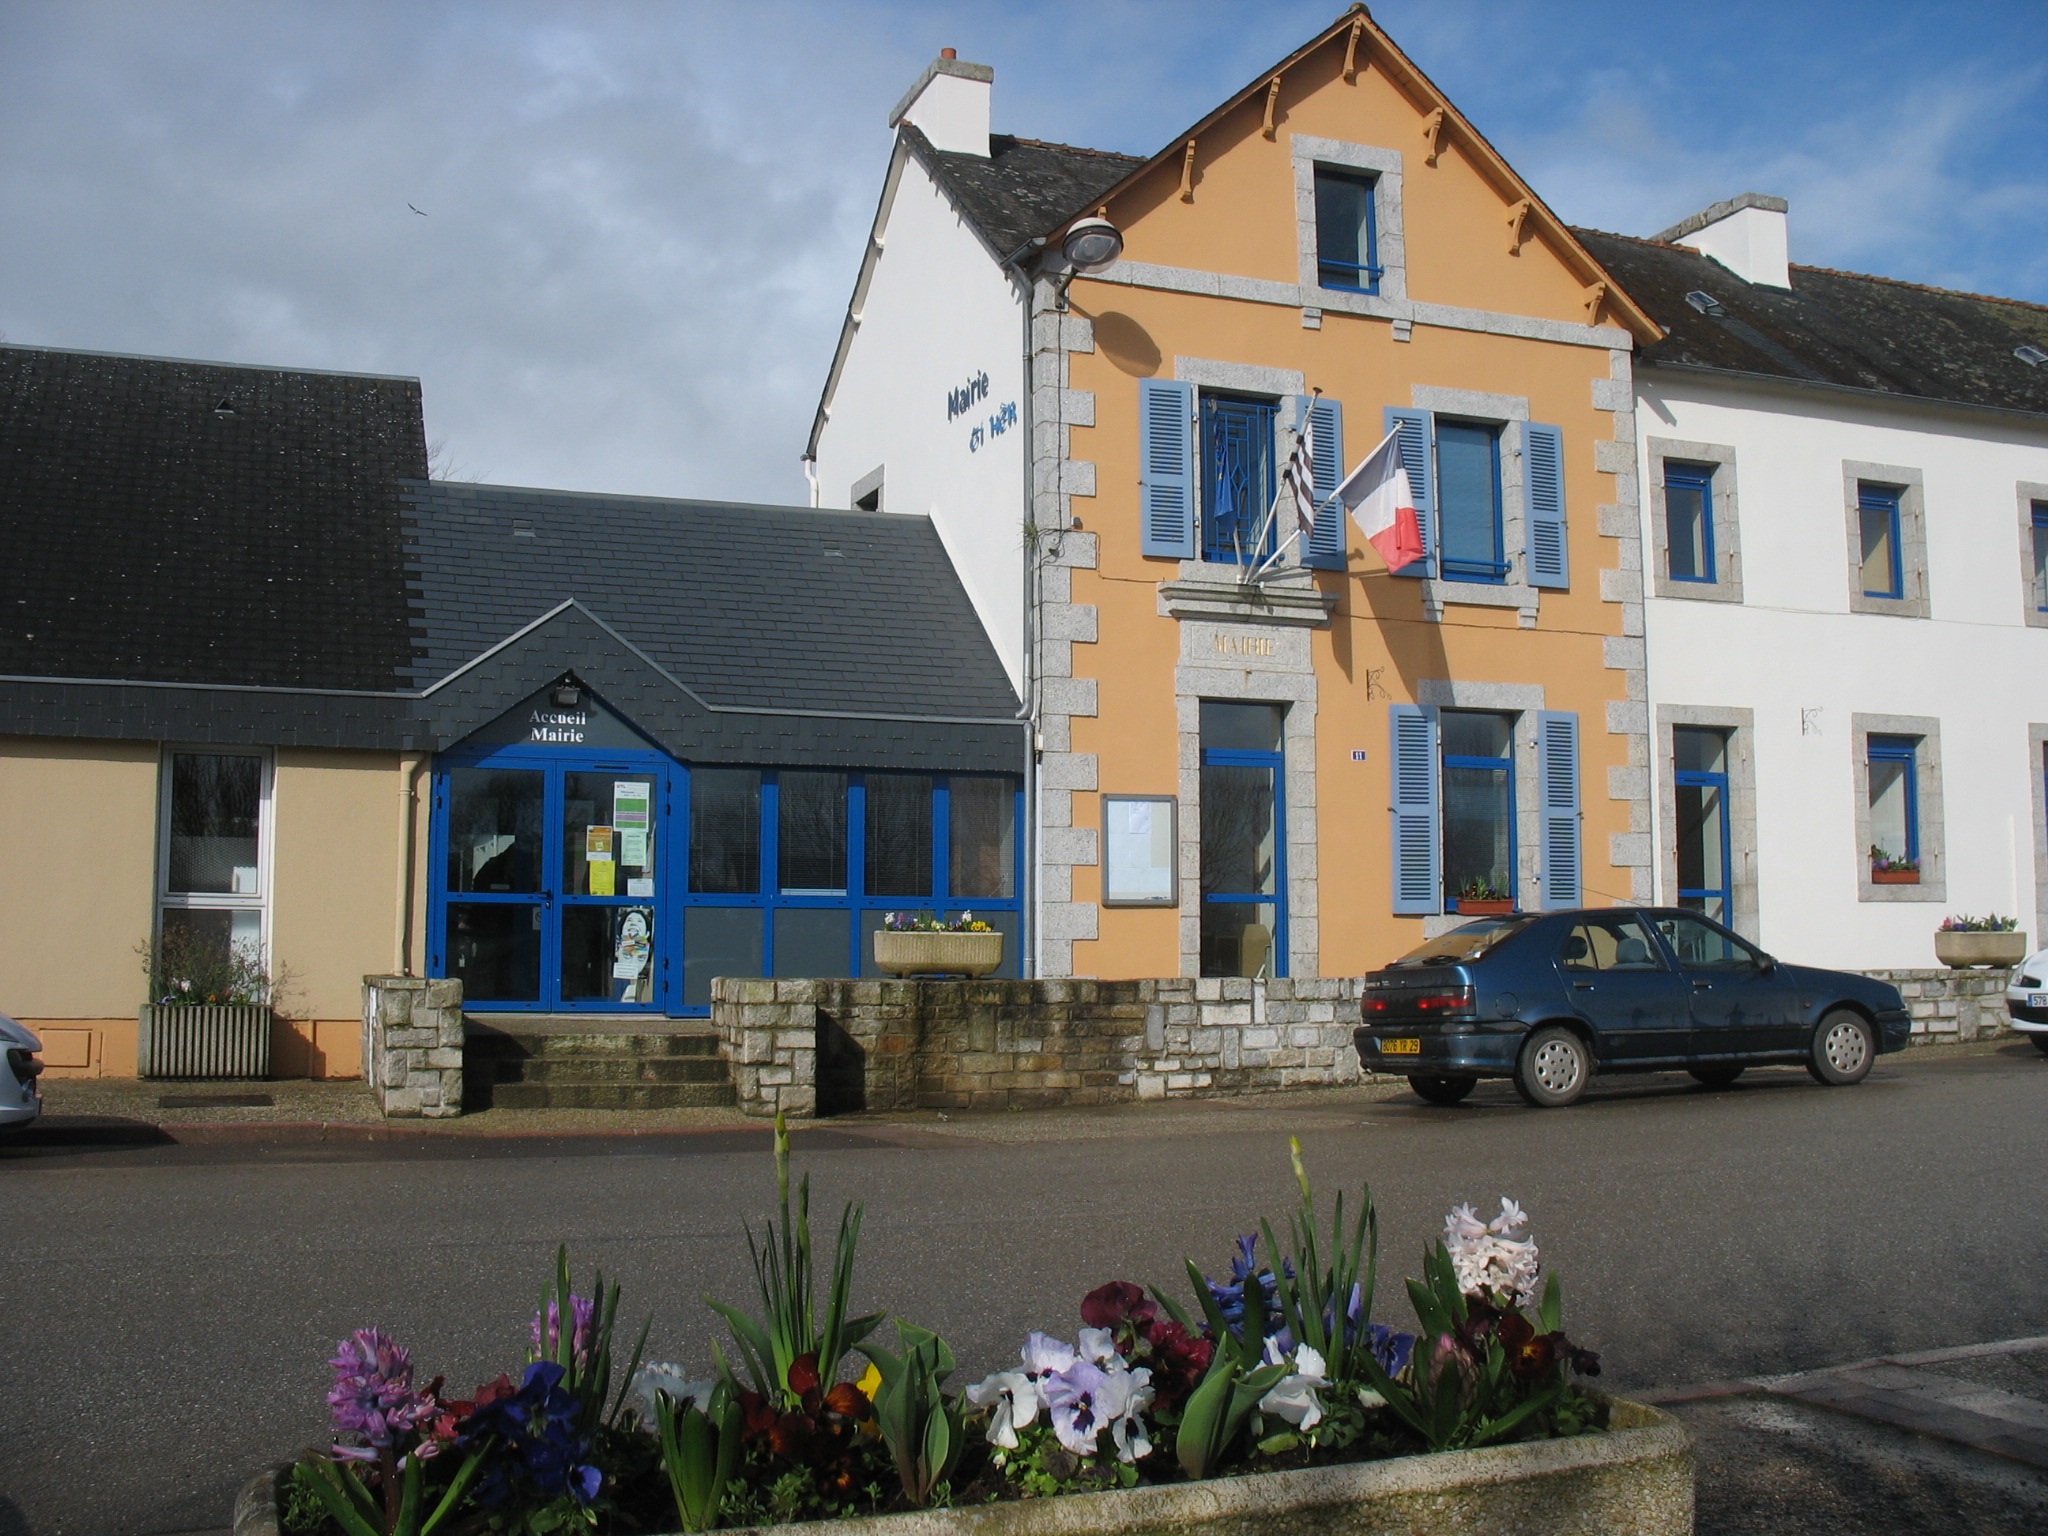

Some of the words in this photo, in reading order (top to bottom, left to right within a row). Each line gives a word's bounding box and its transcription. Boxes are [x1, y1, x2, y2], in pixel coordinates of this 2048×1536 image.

[947, 369, 989, 423] Mairie
[1214, 634, 1276, 656] MAIRIE
[529, 710, 587, 726] Accueil
[530, 727, 585, 743] Mairie
